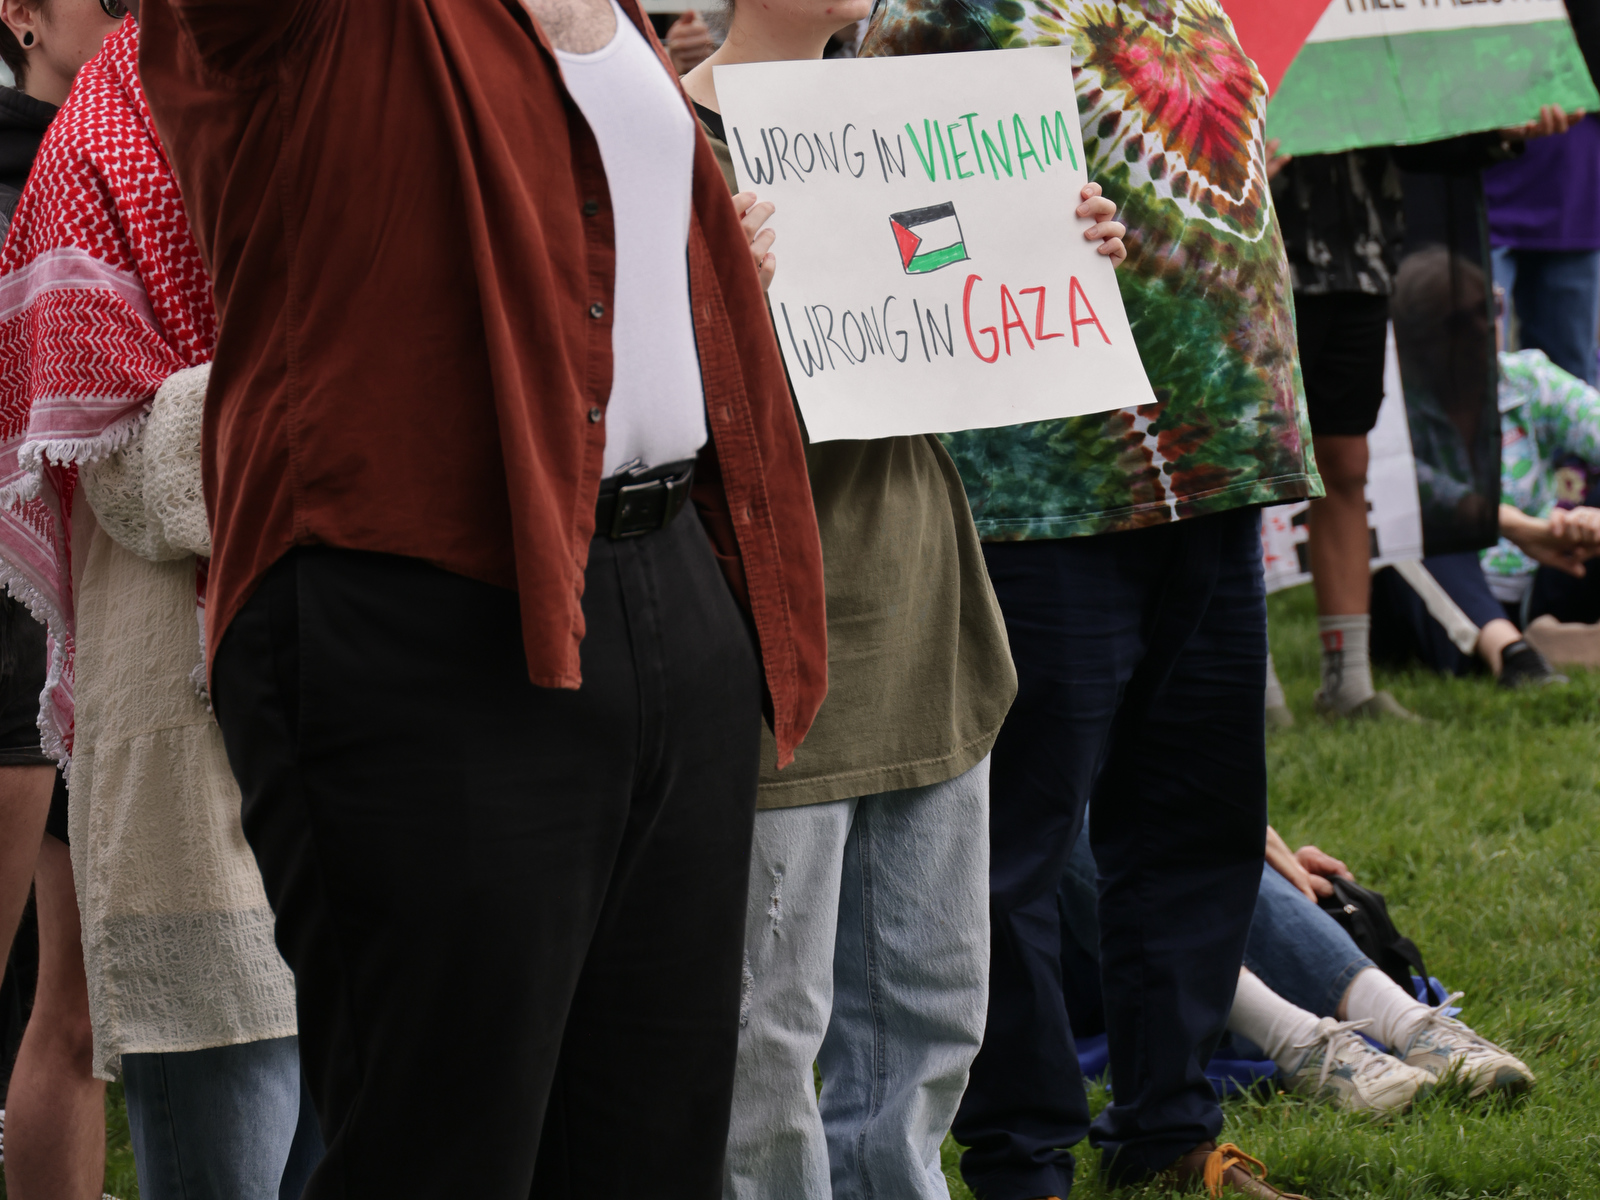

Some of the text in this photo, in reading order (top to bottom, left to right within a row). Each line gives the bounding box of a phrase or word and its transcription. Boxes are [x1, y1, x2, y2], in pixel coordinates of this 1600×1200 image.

[733, 110, 1079, 186] WRONG IN VIETNAM
[781, 274, 1113, 378] WRONG IN GAZA
